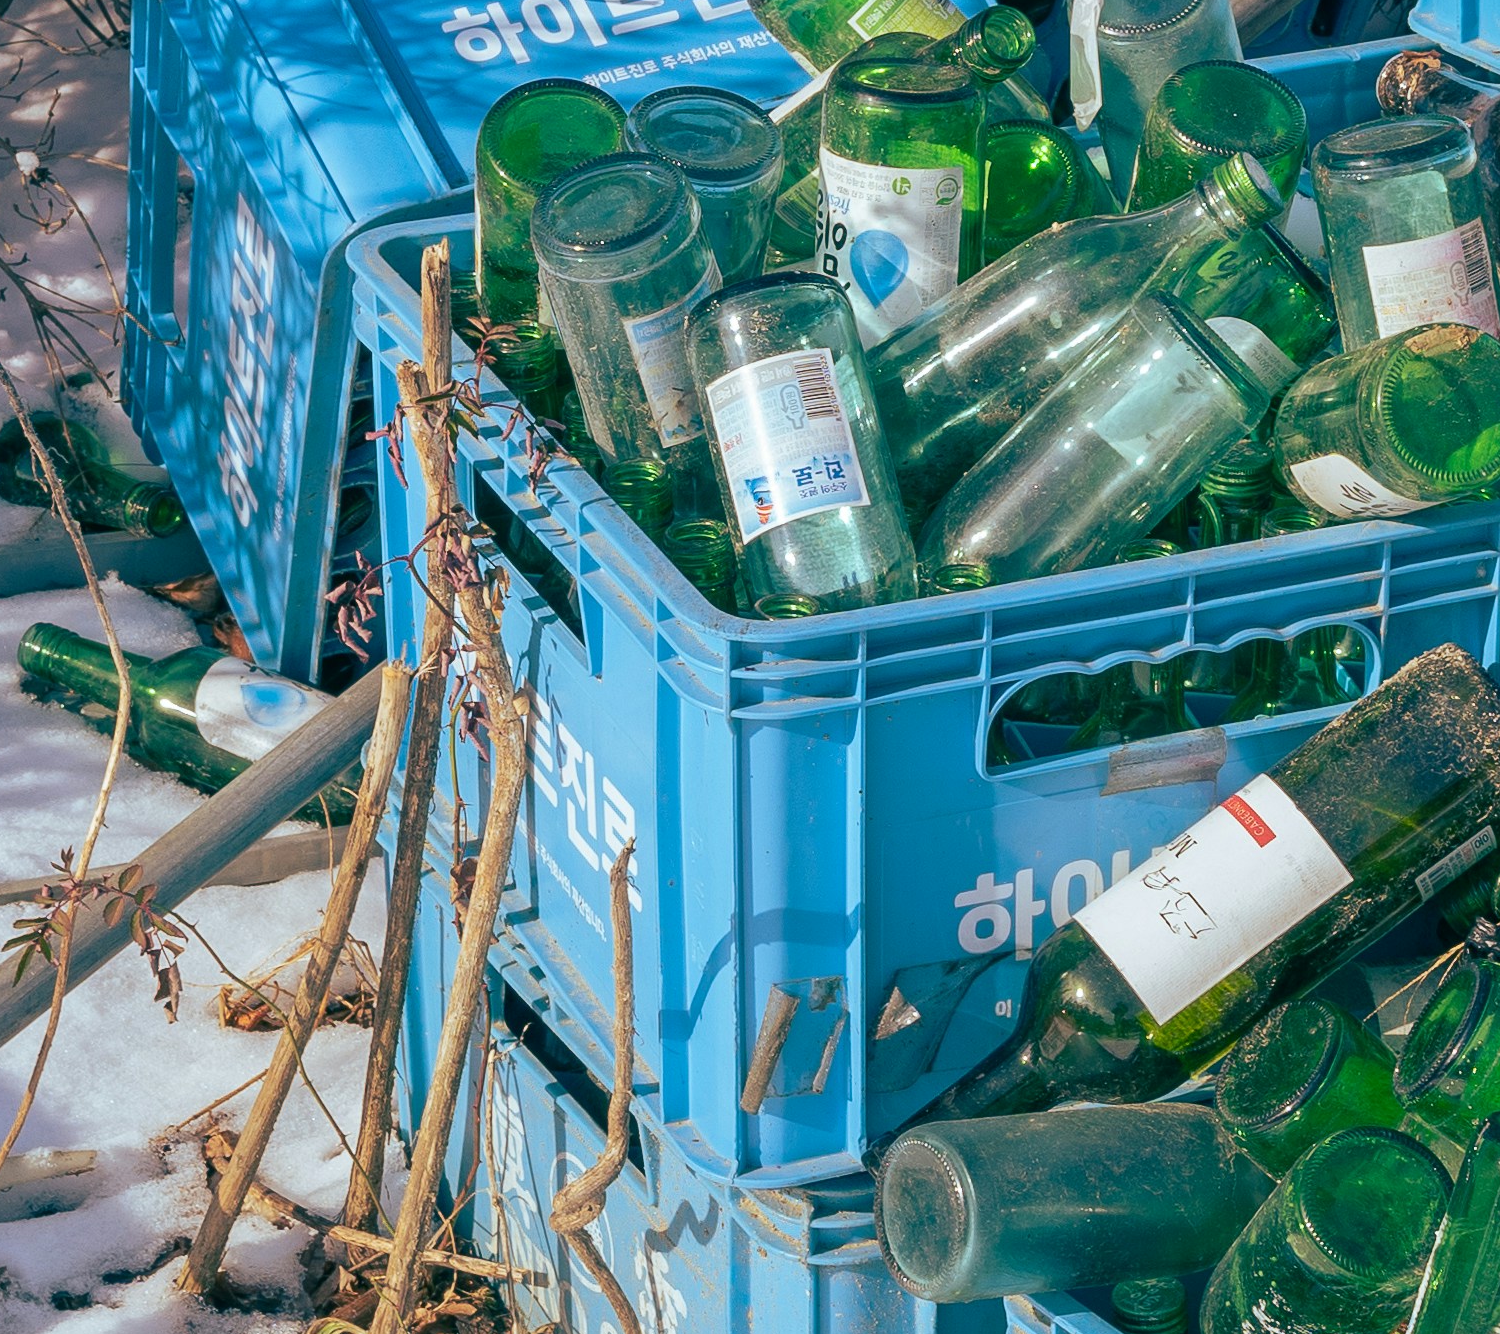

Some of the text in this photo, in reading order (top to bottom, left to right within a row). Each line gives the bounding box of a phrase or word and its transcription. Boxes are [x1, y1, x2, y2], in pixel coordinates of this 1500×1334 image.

[660, 40, 736, 70] 주식회사의
[217, 192, 277, 529] 하이트진로
[797, 478, 848, 500] 소주의 원조
